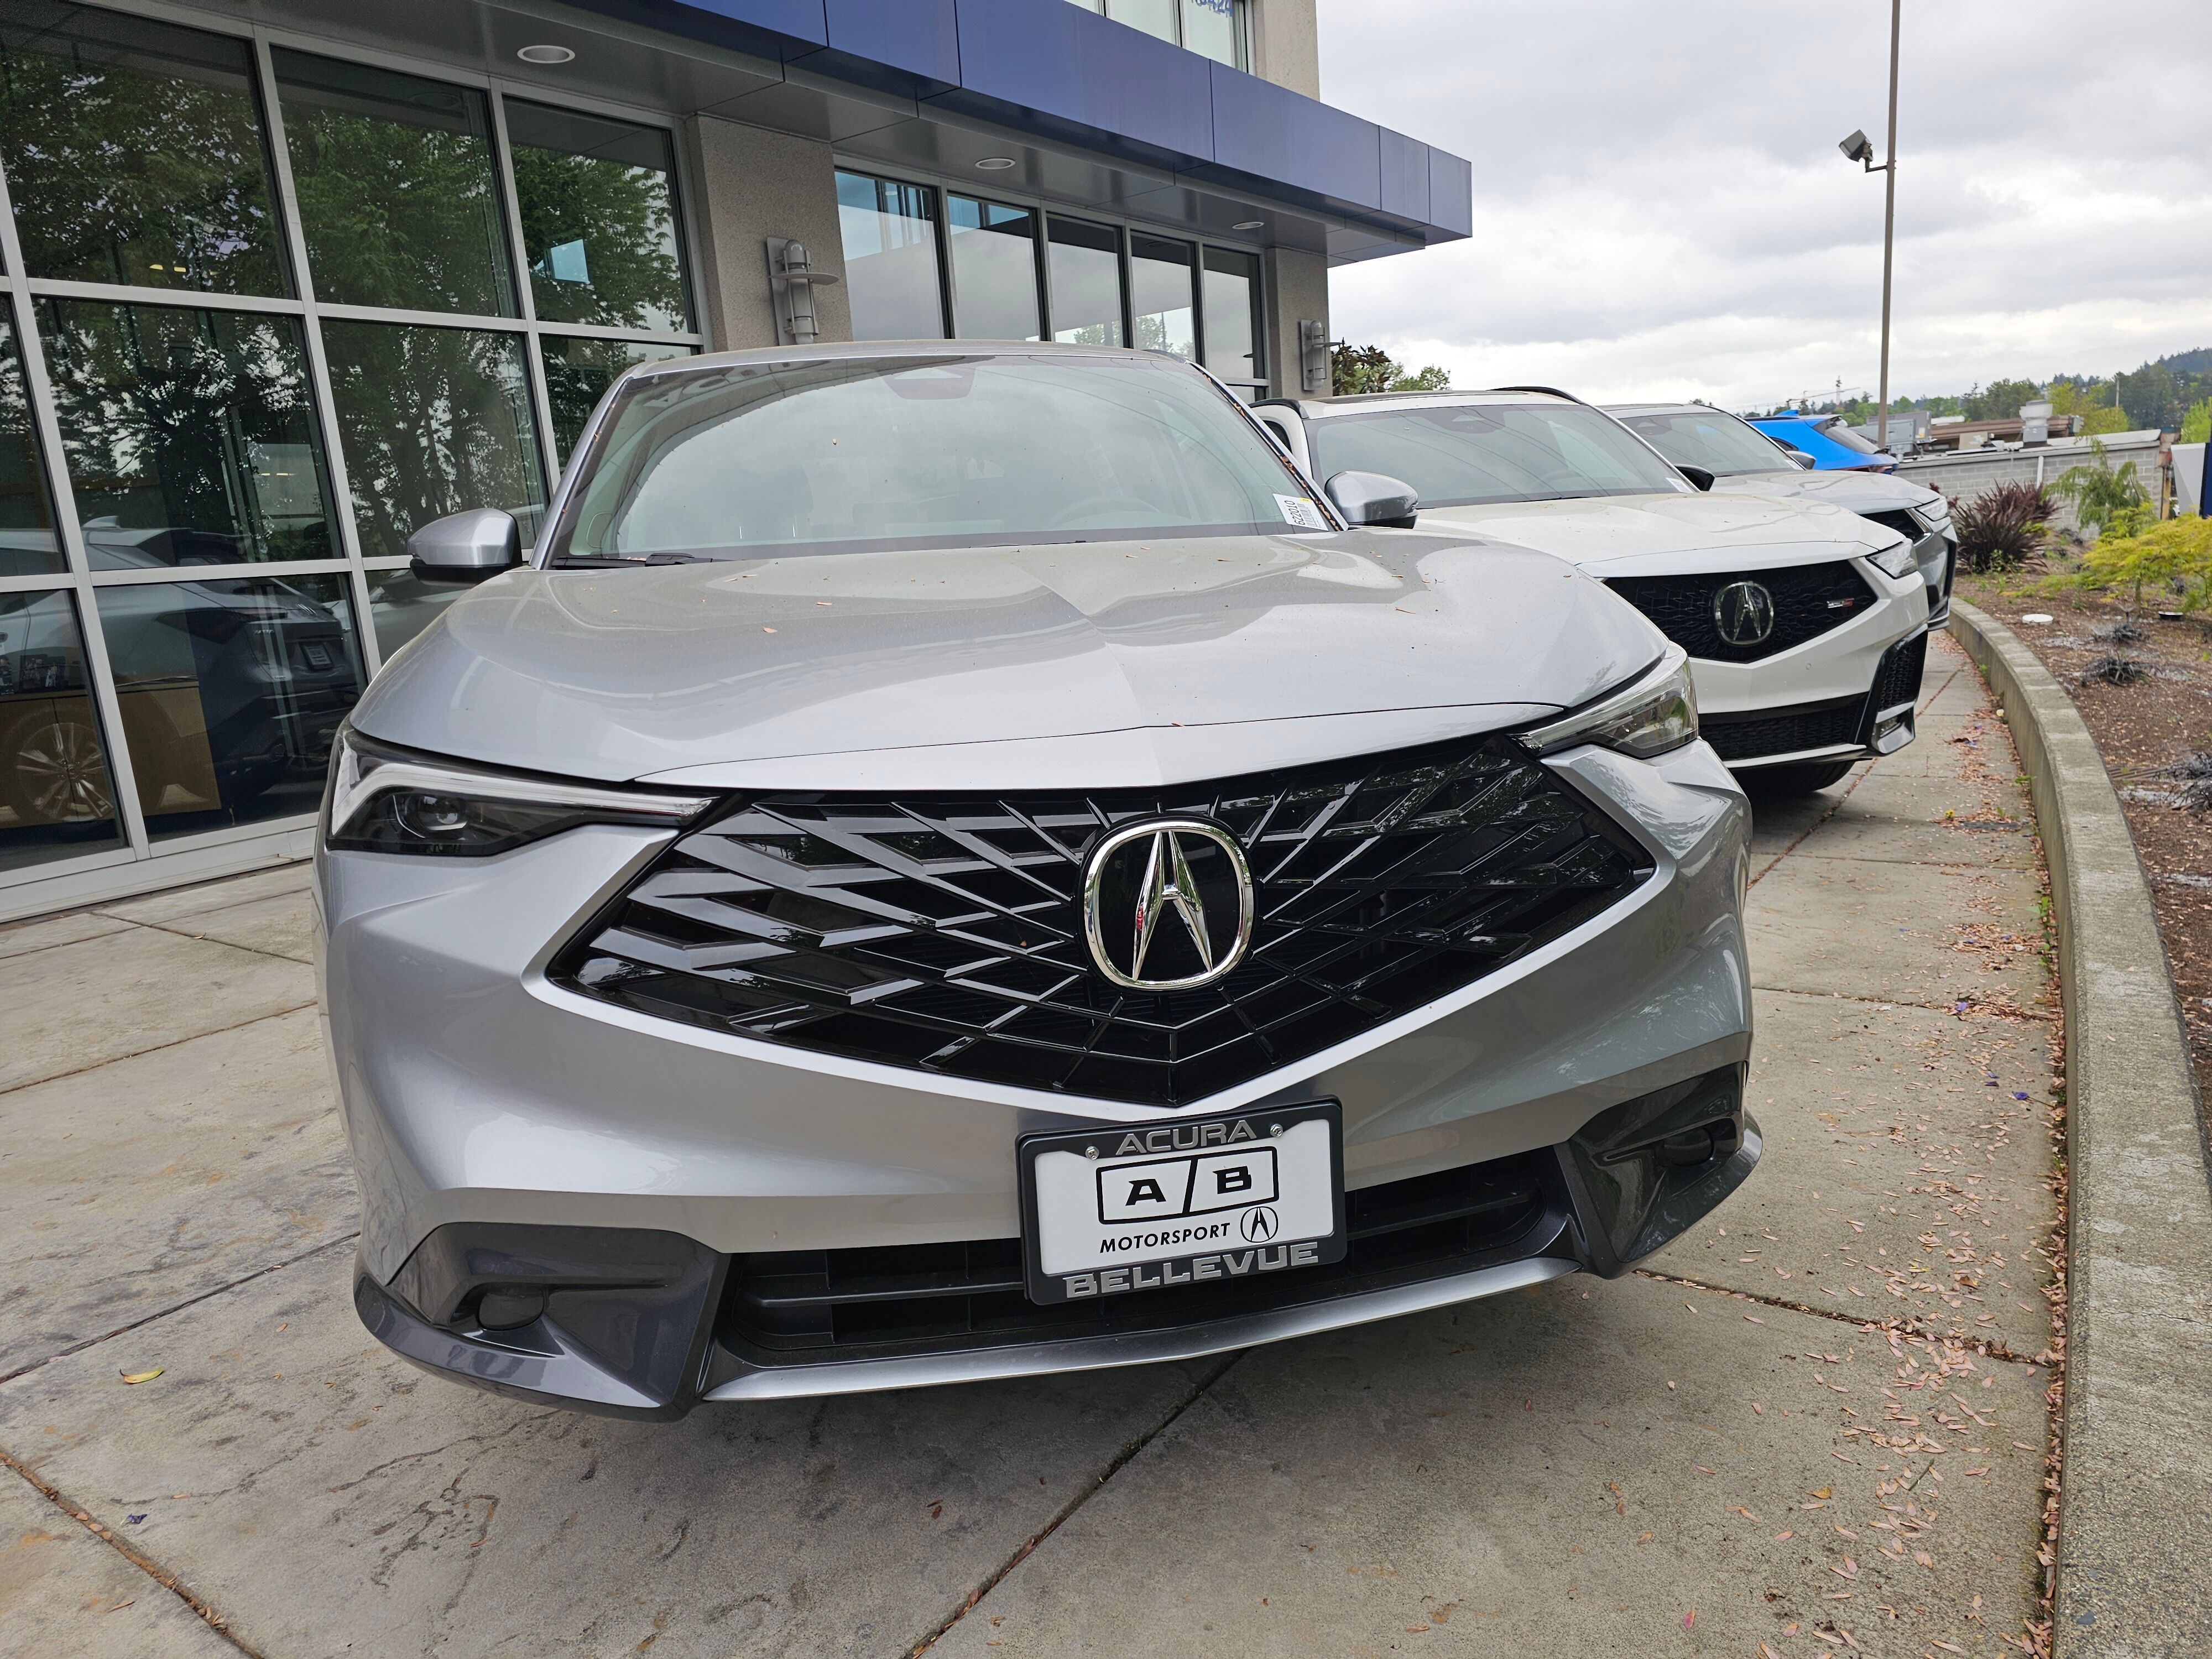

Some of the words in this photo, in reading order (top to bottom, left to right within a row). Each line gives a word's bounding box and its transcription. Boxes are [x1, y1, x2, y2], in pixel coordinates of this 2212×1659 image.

[1284, 500, 1305, 525] 622010
[1115, 1120, 1257, 1155] ACURA
[1100, 1223, 1230, 1253] MOTORSPORT
[1062, 1242, 1319, 1298] BELLEVUE
